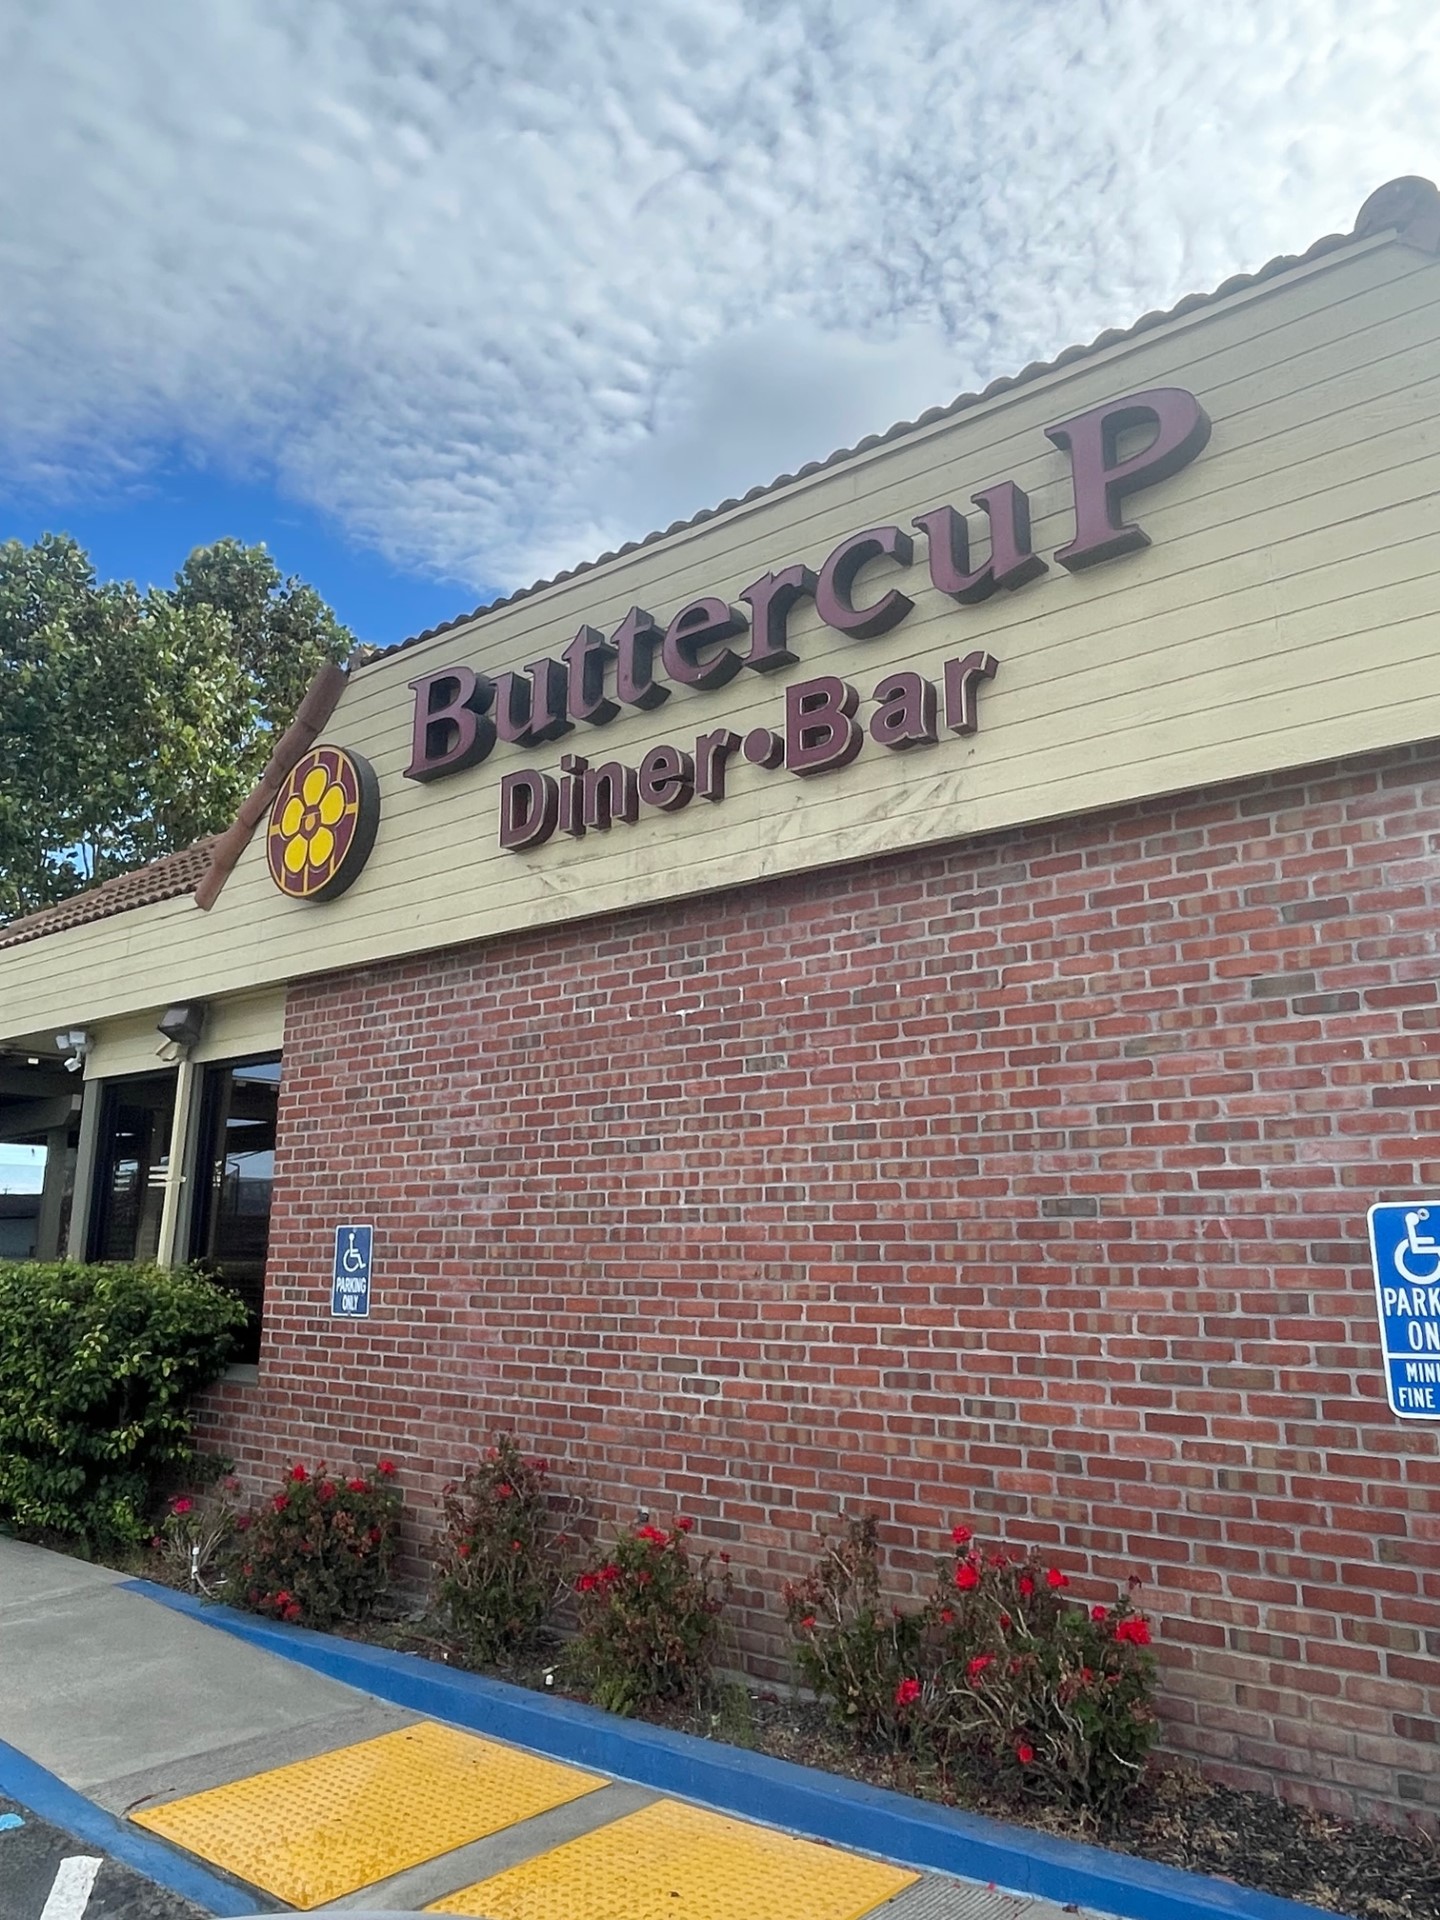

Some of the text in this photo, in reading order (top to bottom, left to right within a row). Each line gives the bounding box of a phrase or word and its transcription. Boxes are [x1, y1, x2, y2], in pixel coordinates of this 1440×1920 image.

[336, 1277, 366, 1293] PARKING
[342, 1294, 359, 1311] ONLY
[1384, 1287, 1440, 1317] PARK
[1408, 1321, 1440, 1351] ON
[1399, 1387, 1436, 1408] FINE
